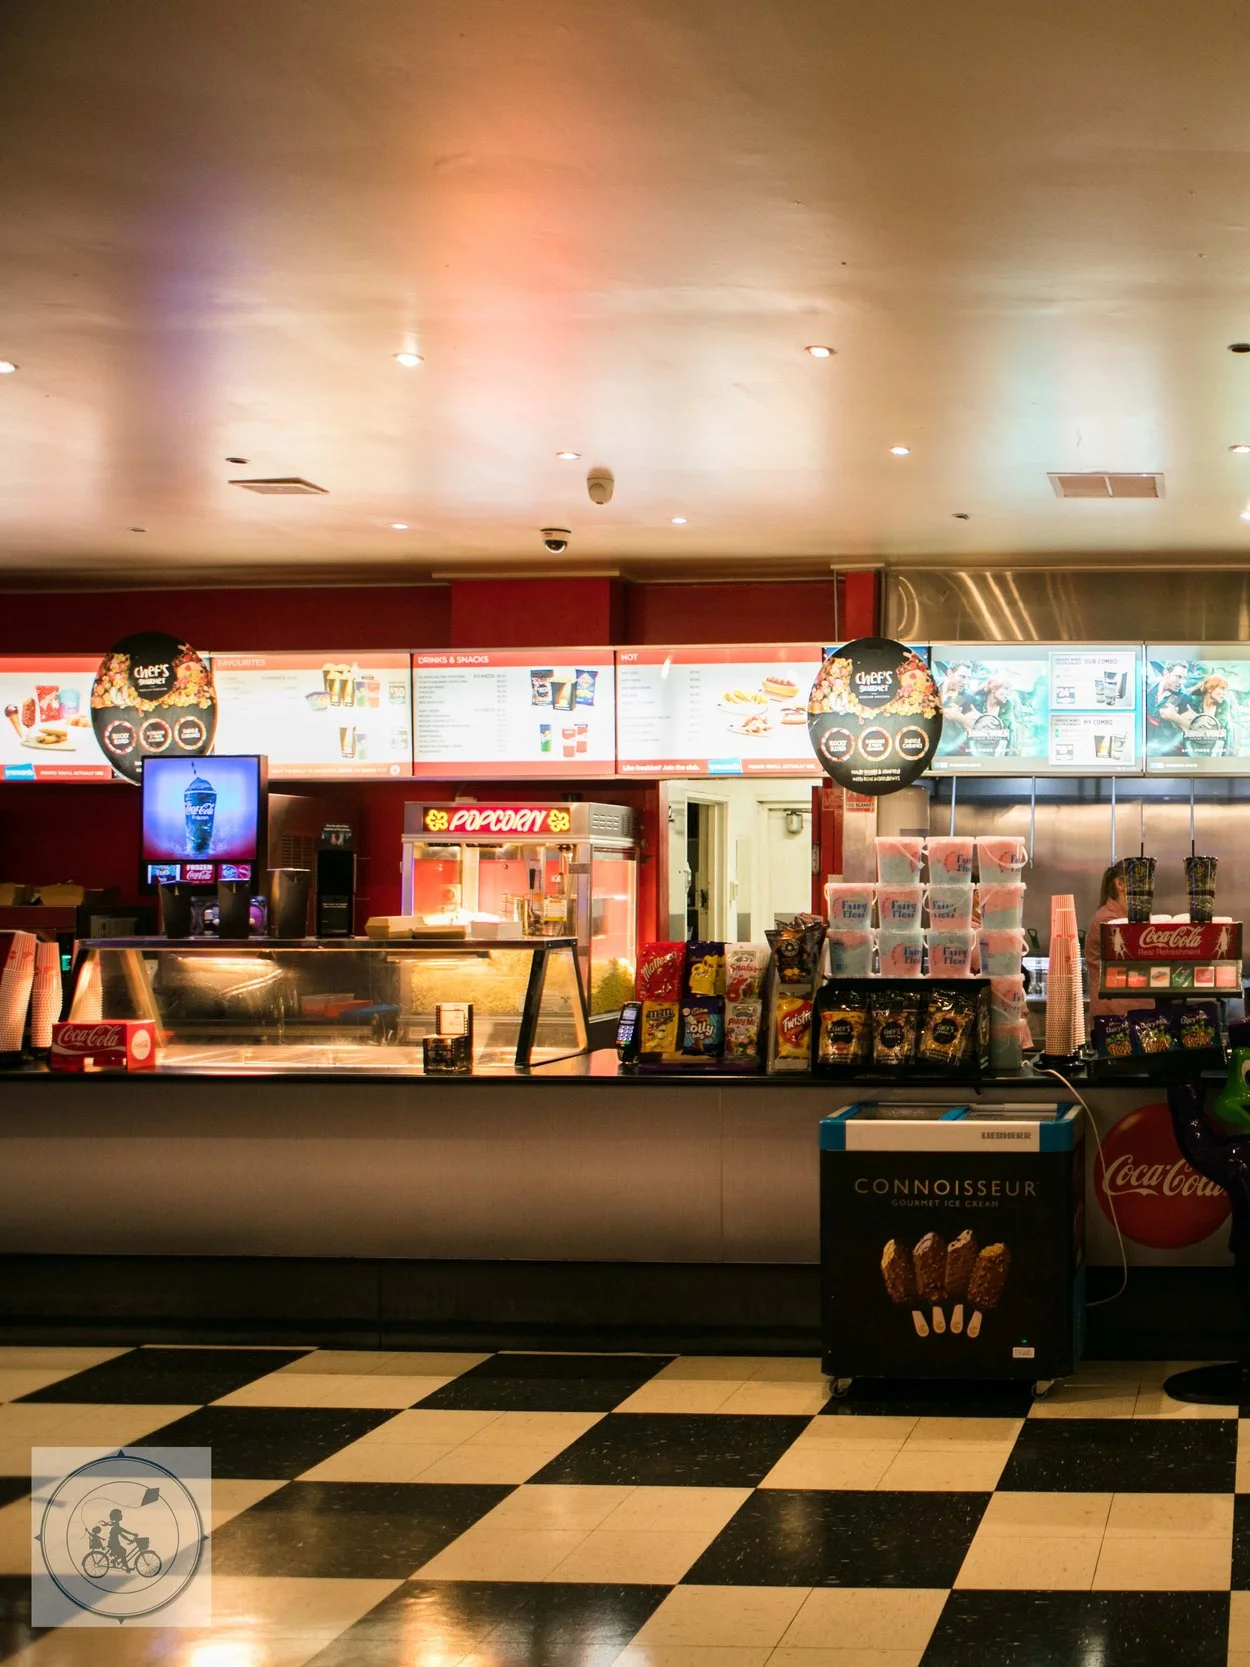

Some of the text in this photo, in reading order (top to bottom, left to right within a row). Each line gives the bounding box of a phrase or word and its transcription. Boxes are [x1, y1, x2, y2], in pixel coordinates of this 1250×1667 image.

[217, 659, 266, 667] FAVOURITES
[418, 656, 447, 664] DRINKS
[449, 809, 548, 832] POPCORN
[186, 870, 212, 880] Coca-Cola
[842, 900, 868, 912] Fairy
[891, 900, 917, 912] Fairy
[843, 910, 867, 919] Floss
[892, 910, 916, 919] Floss
[1138, 926, 1205, 948] Coca-Cola
[904, 946, 921, 956] Fair
[943, 946, 968, 958] Fairy
[904, 955, 921, 964] Flo
[944, 955, 967, 965] Floss
[641, 950, 678, 982] Maltesers
[782, 1010, 812, 1033] Twistie
[57, 1024, 122, 1048] Coca-Cola
[981, 1132, 1032, 1140] LIEBHERR
[854, 1178, 1037, 1197] CONNOISSEUR
[891, 1199, 999, 1208] GOURMET ICE CREAM
